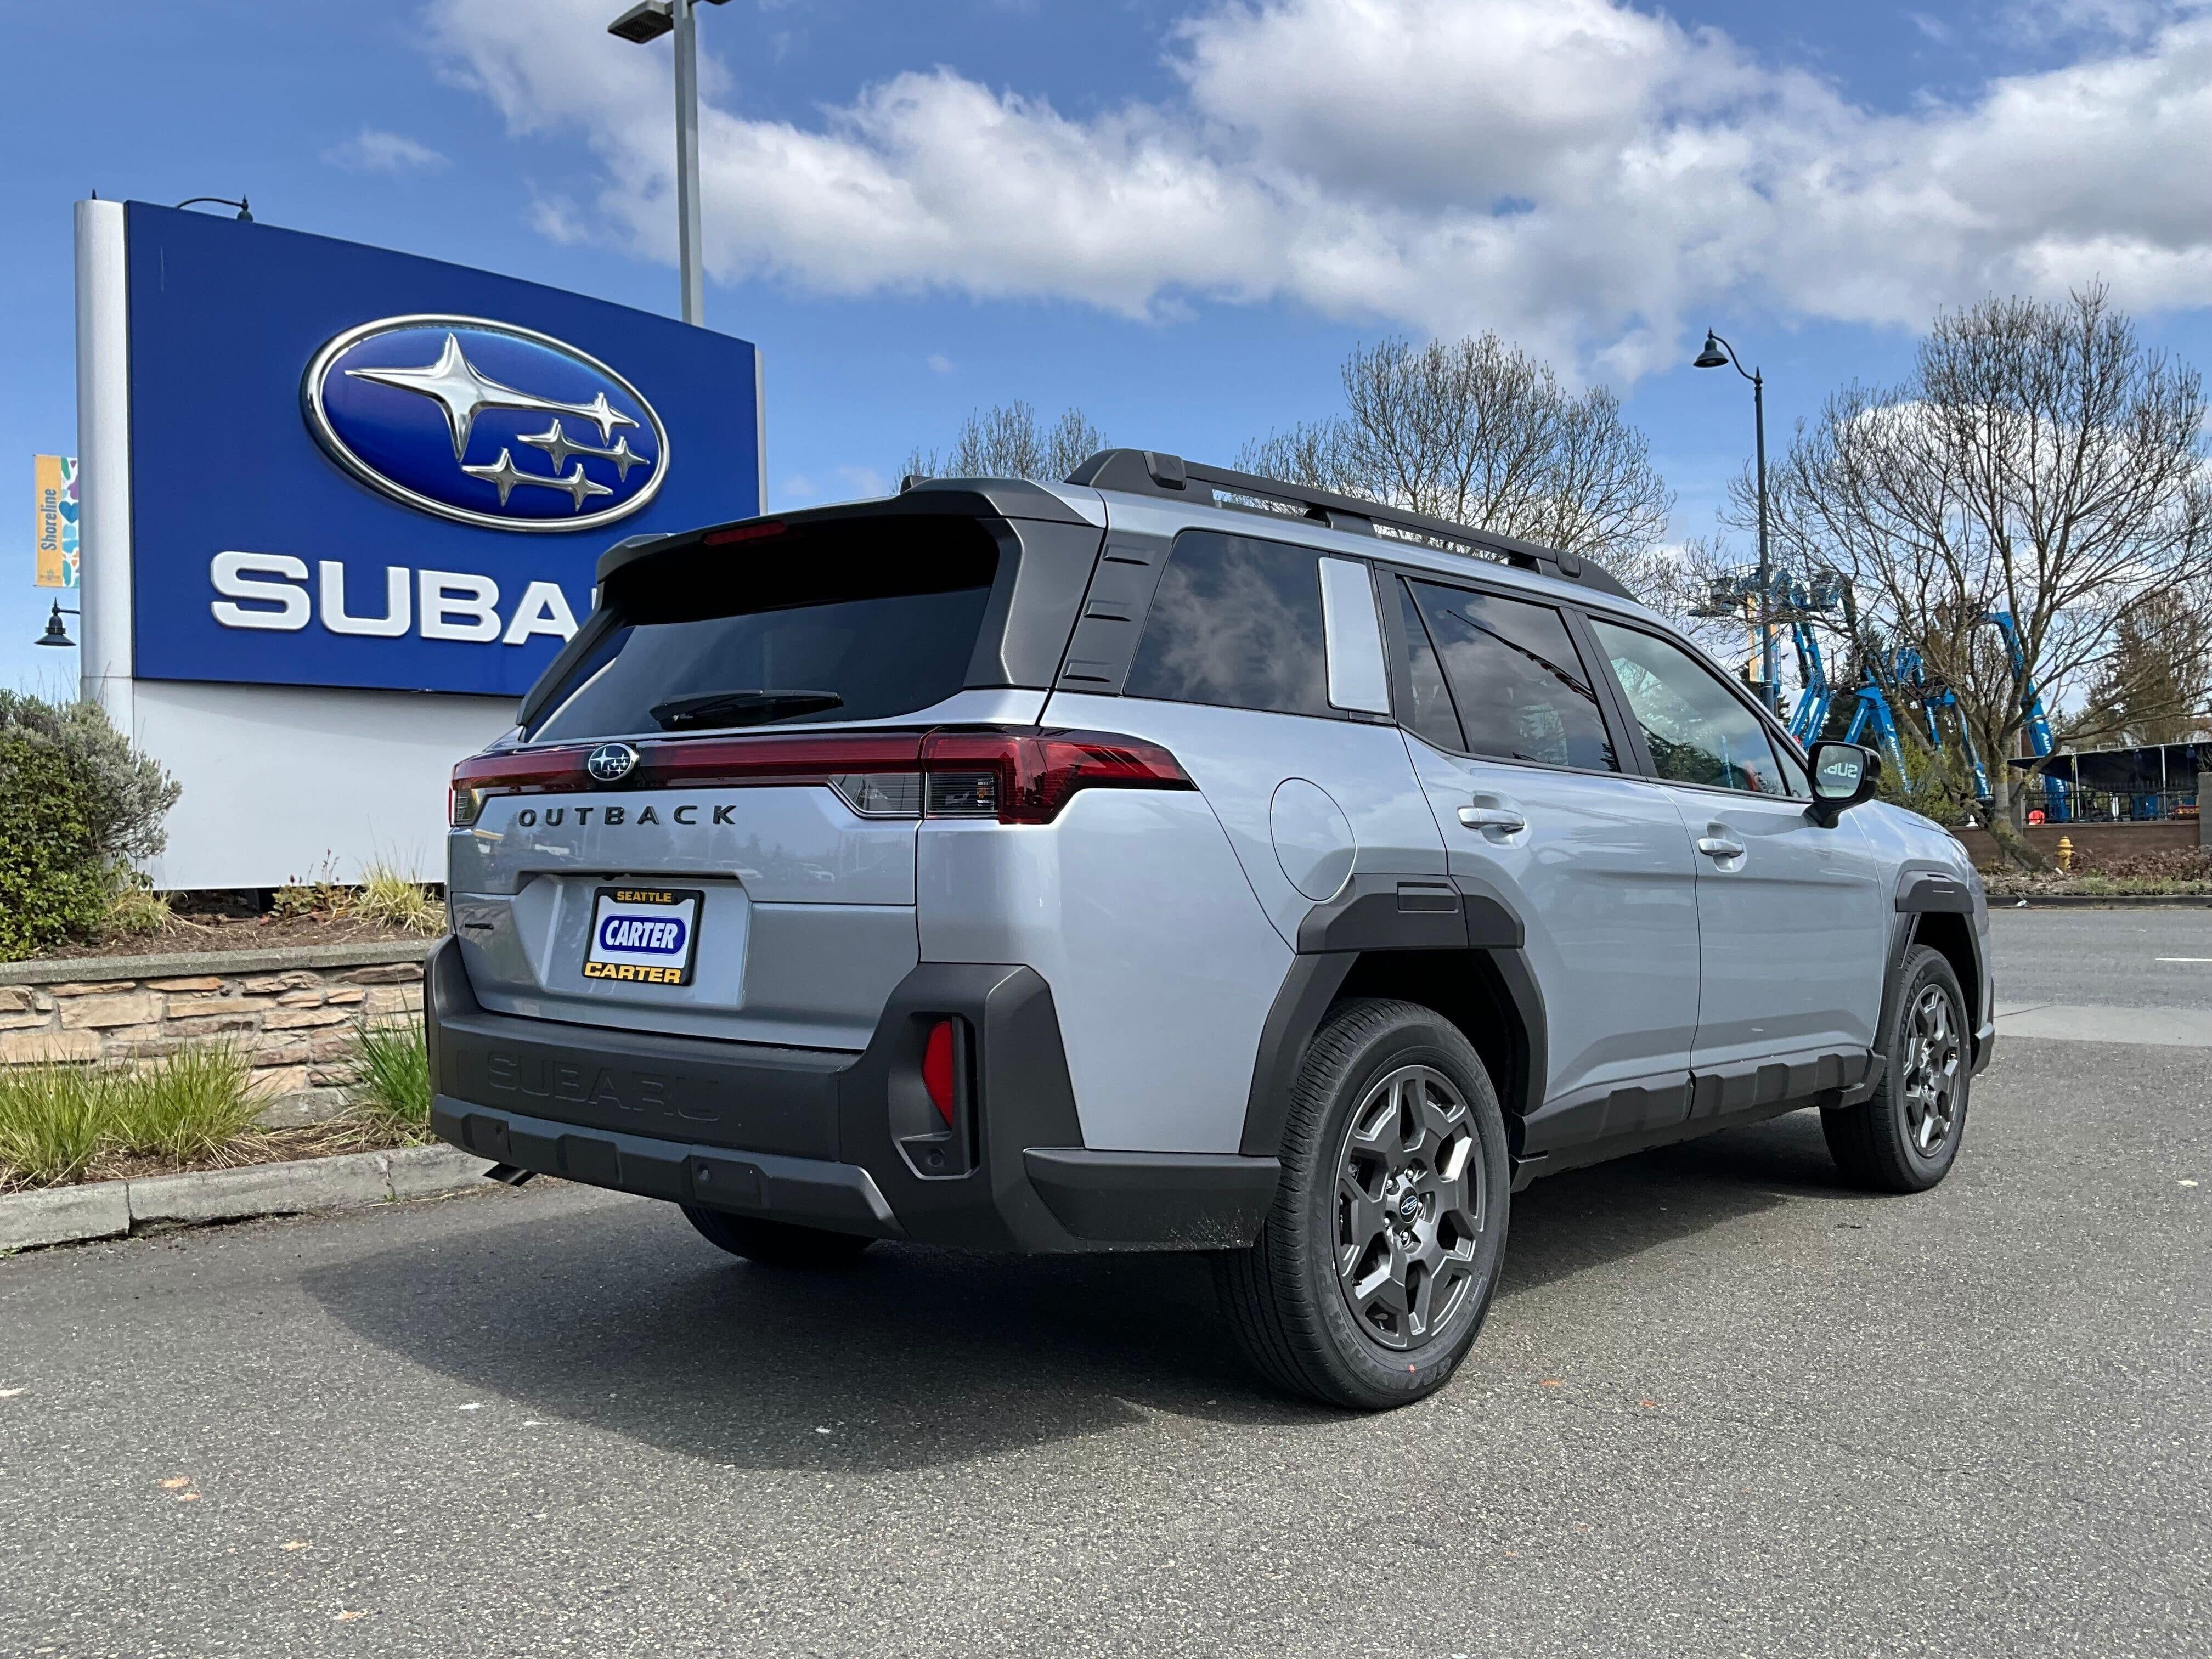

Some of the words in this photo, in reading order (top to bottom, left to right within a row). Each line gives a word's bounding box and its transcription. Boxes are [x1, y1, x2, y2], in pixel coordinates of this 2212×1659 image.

[41, 488, 57, 551] Shoreline
[211, 551, 598, 645] SUBA
[518, 804, 737, 827] OUTBACK
[617, 891, 673, 903] SEATTLE
[605, 919, 678, 950] CARTER
[584, 962, 681, 984] CARTER
